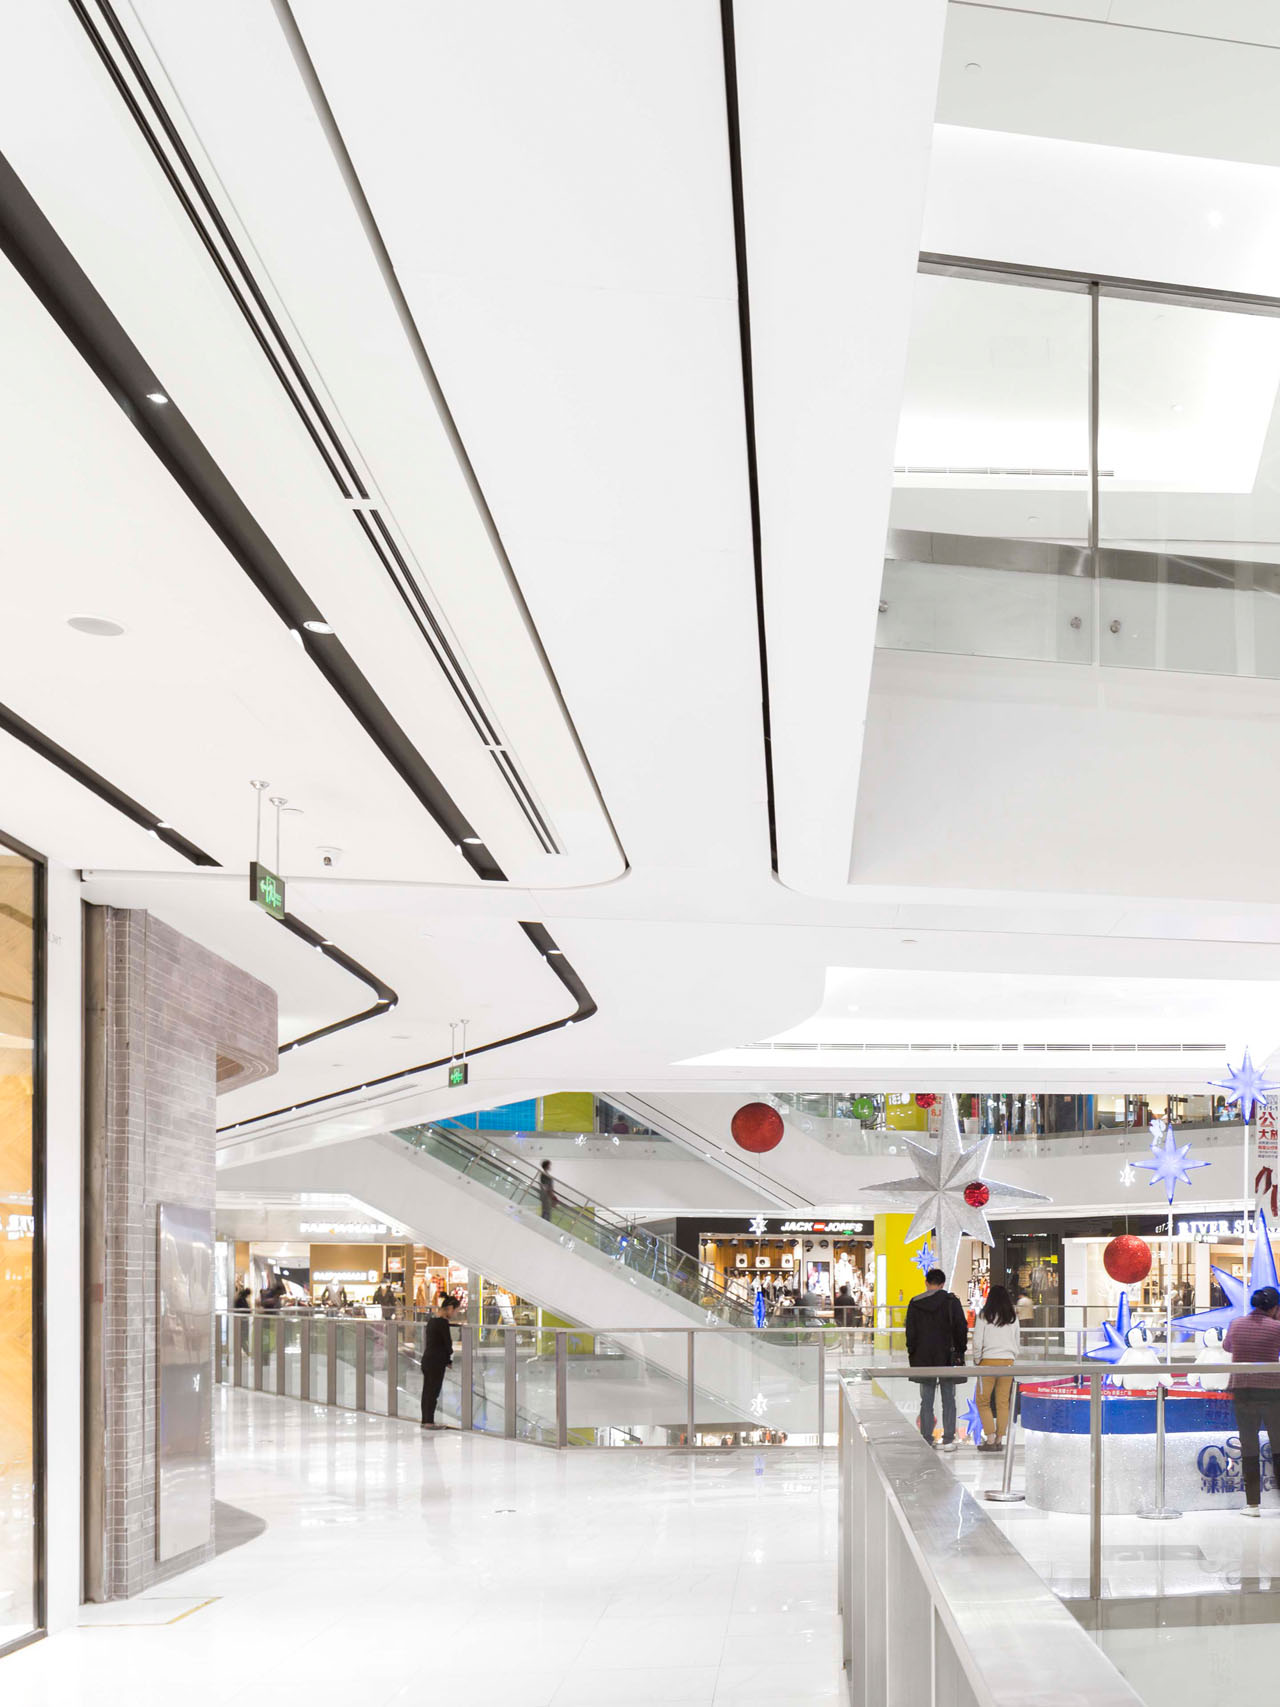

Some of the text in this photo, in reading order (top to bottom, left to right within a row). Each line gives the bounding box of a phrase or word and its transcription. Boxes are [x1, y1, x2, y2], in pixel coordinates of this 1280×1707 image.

[781, 1222, 863, 1233] JACK JONES
[1178, 1220, 1229, 1235] RIVER
